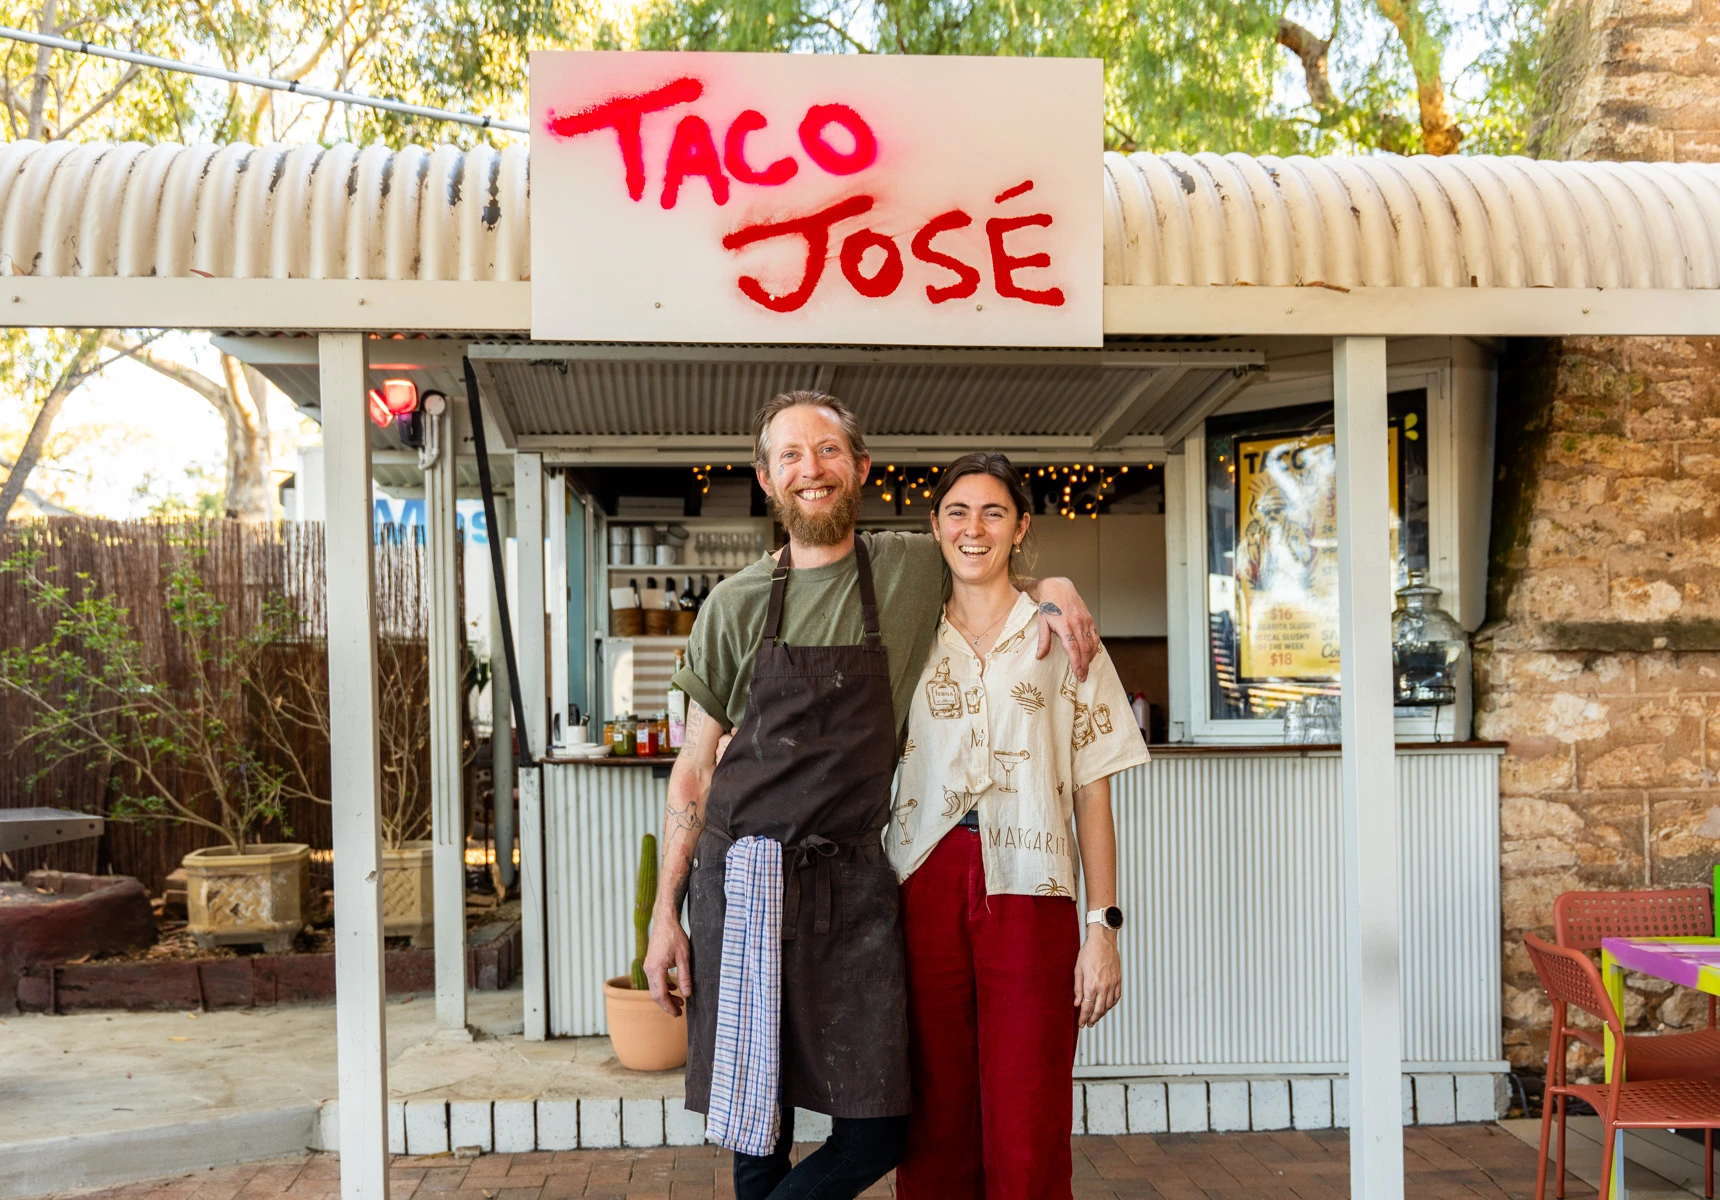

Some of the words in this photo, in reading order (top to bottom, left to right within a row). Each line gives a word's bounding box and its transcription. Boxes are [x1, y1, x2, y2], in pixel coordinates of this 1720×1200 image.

[547, 77, 877, 209] TACO
[723, 180, 1065, 312] JOSÉ
[1270, 607, 1293, 621] $16
[1284, 643, 1305, 651] WEEK
[1270, 652, 1293, 666] $18
[988, 826, 1070, 857] MARGARIT
